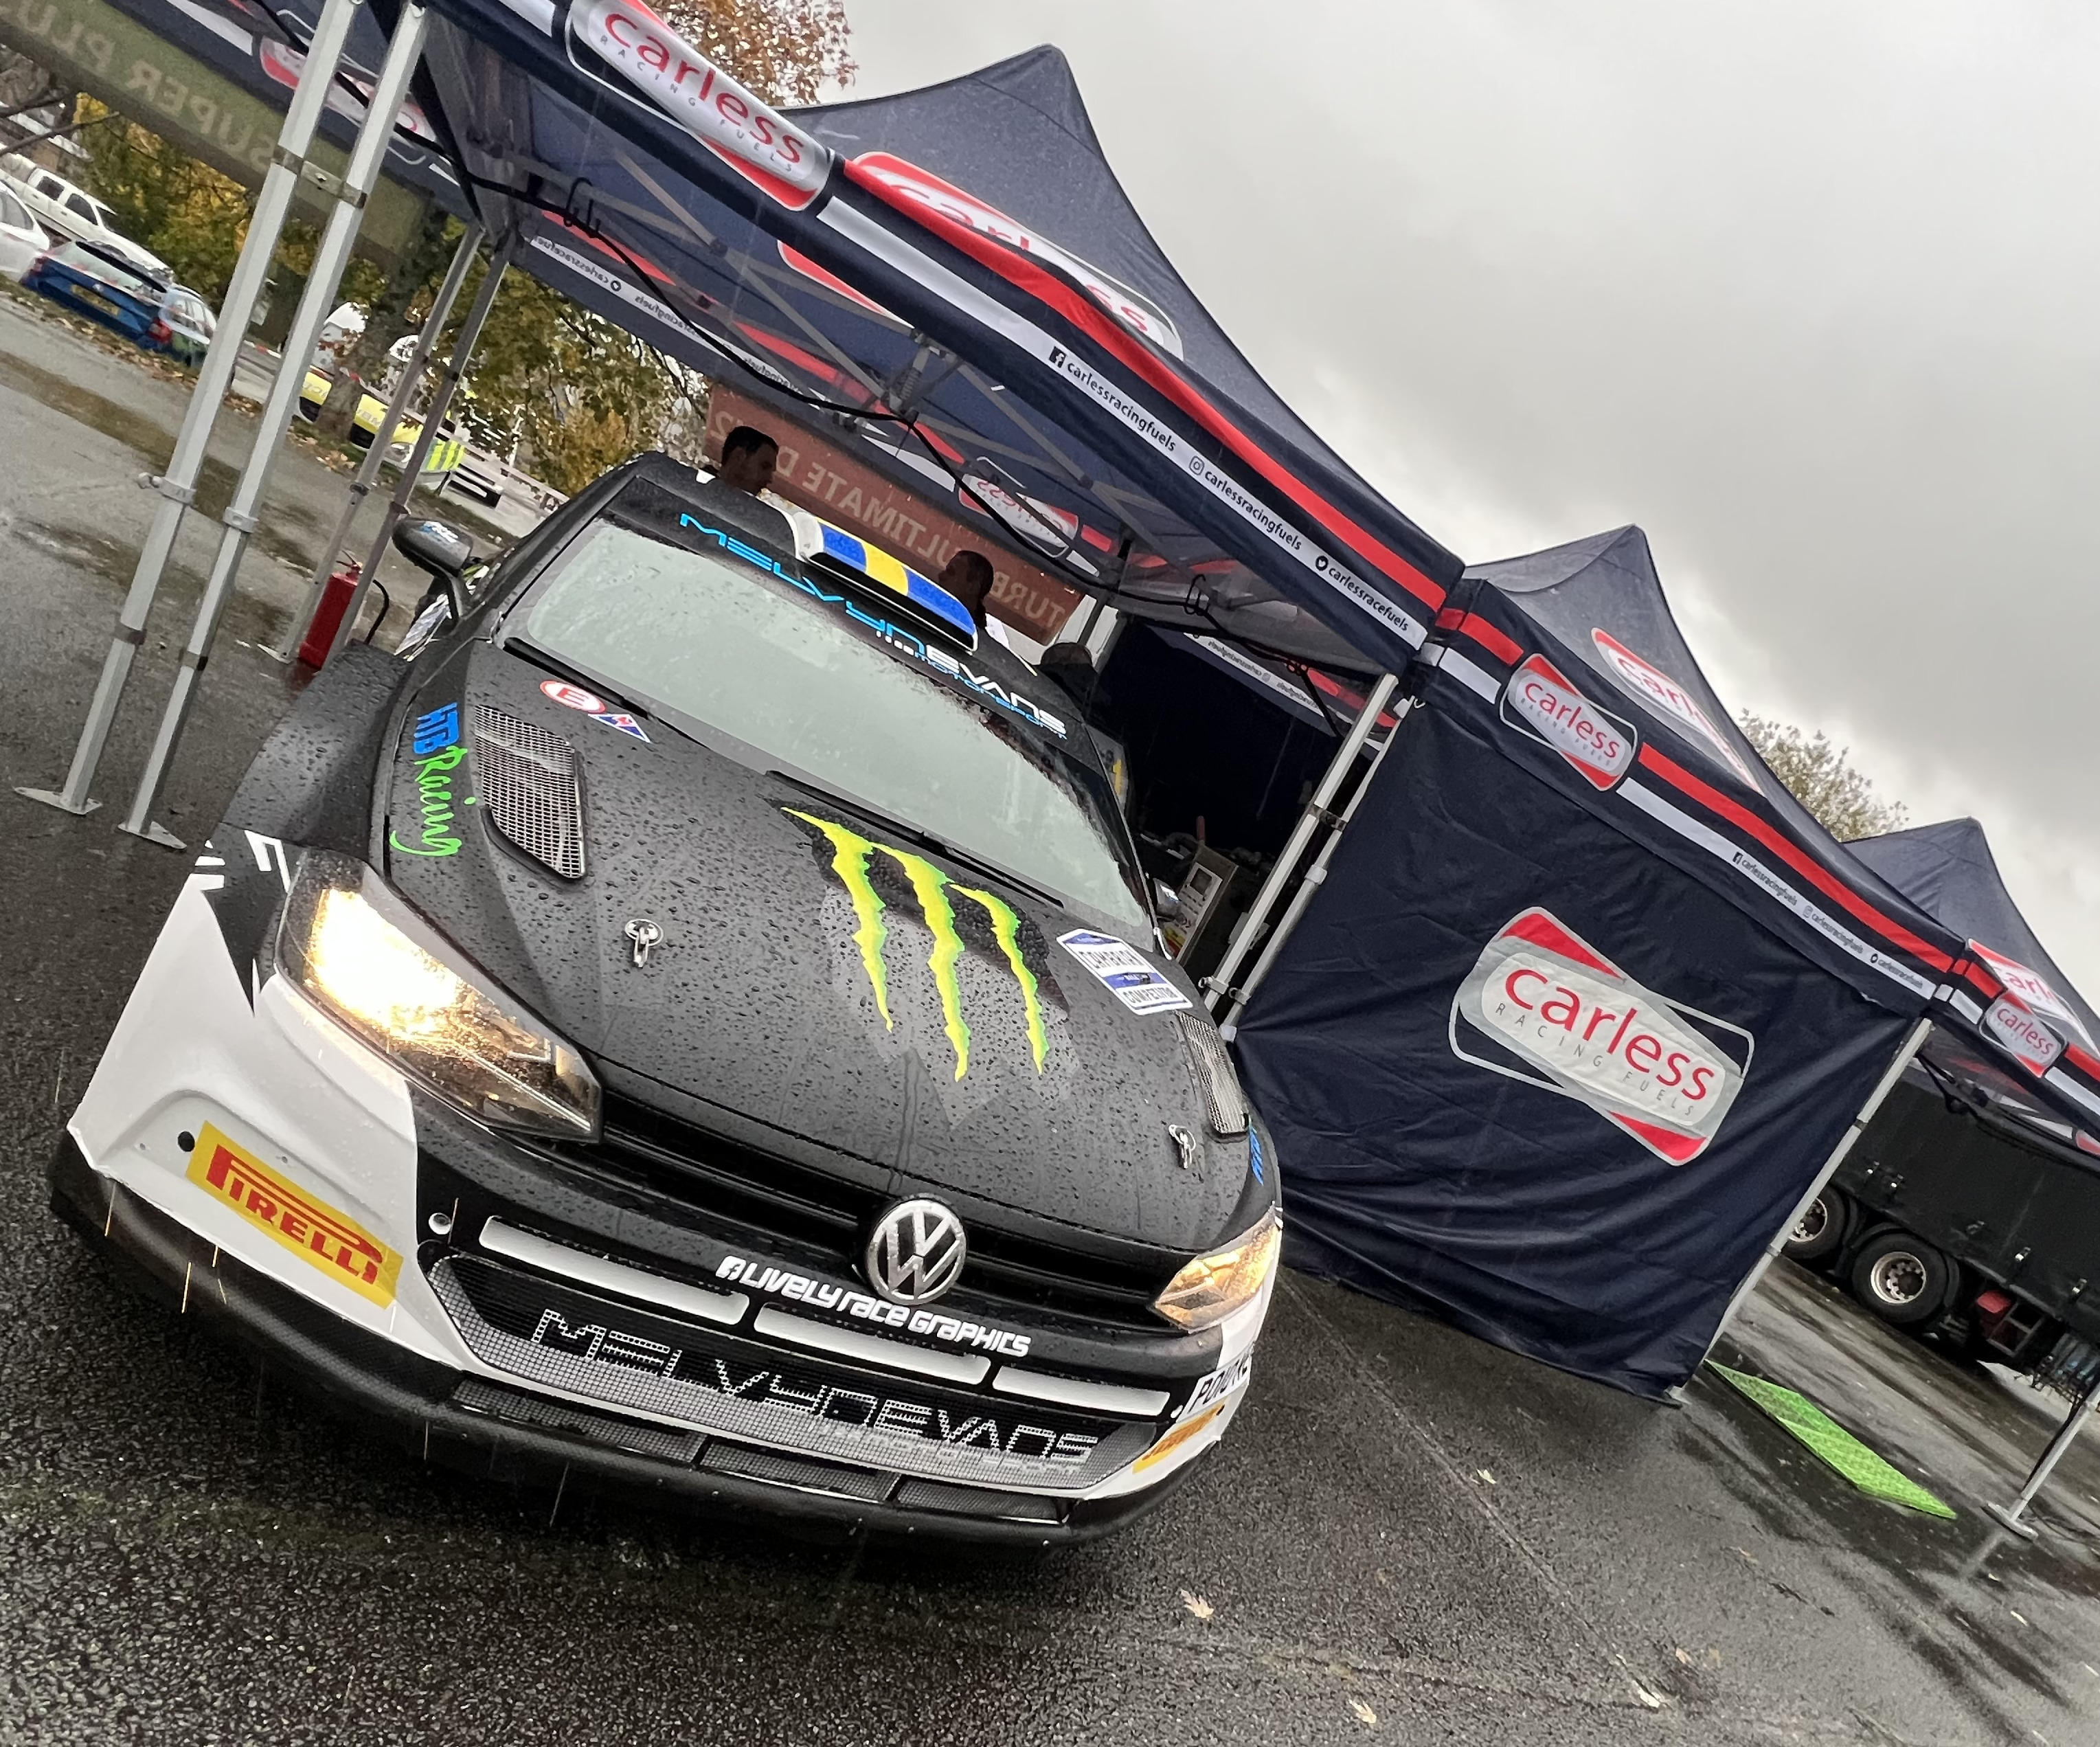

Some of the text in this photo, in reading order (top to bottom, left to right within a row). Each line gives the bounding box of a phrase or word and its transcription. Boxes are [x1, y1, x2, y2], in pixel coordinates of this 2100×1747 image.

[600, 35, 793, 172] RACING FUELS
[605, 13, 804, 164] carless
[1067, 362, 1408, 632] carlessracingfuels carlessracingfuels carlessracefuels
[1525, 682, 1620, 758] carless
[389, 745, 477, 855] Racing
[1495, 1003, 1695, 1116] RACING FUELS
[1505, 969, 1715, 1101] carless
[1997, 1008, 2054, 1055] carless
[205, 1144, 383, 1285] PIRELLI
